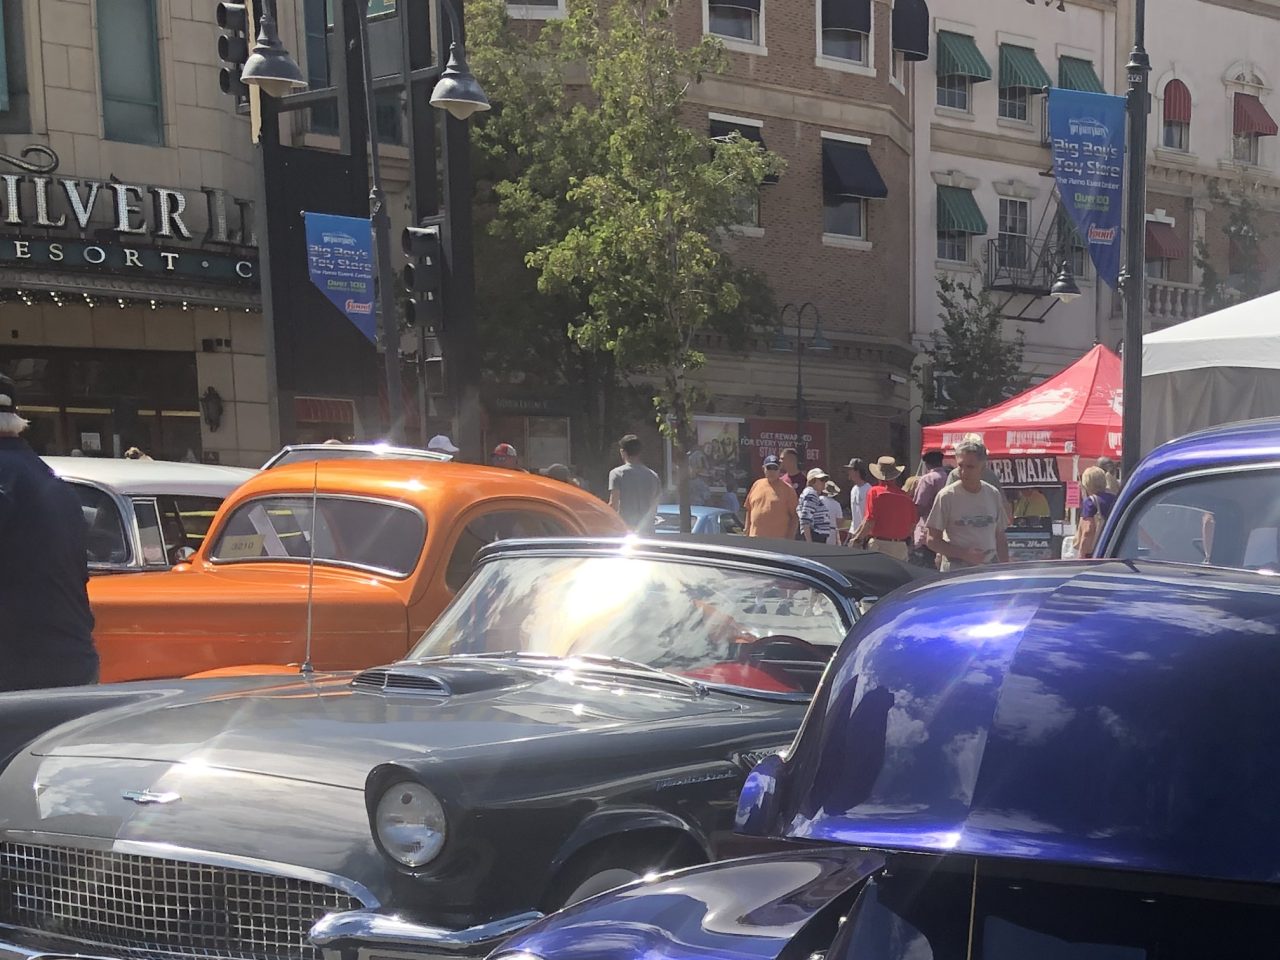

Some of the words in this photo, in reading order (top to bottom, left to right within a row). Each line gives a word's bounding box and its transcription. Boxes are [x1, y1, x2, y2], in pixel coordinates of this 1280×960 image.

[1054, 138, 1079, 158] Big
[1082, 142, 1118, 160] Boy's
[1055, 157, 1084, 176] Toy
[1087, 161, 1120, 178] Store
[1, 174, 193, 240] ILVER
[13, 241, 180, 270] ESORT
[309, 244, 331, 258] Big
[333, 247, 369, 261] Boy's
[309, 256, 335, 269] Toy
[337, 259, 372, 271] Store
[1014, 456, 1058, 483] WALK
